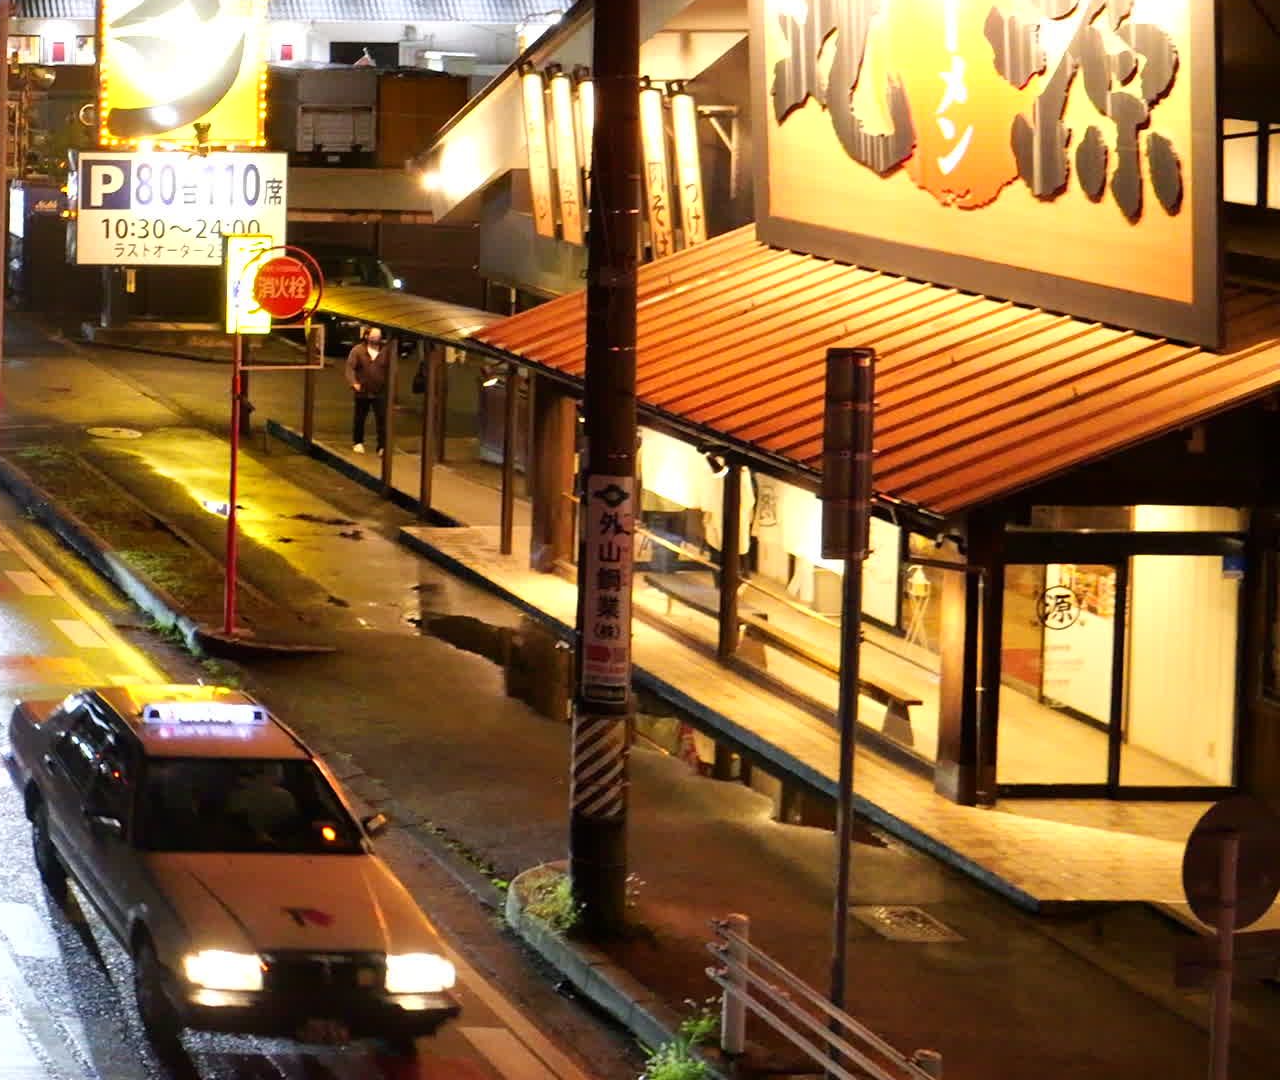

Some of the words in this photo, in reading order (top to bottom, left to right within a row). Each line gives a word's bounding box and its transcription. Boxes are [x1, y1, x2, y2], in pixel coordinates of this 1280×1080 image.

[685, 183, 704, 246] つけ
[257, 276, 307, 299] 消火栓
